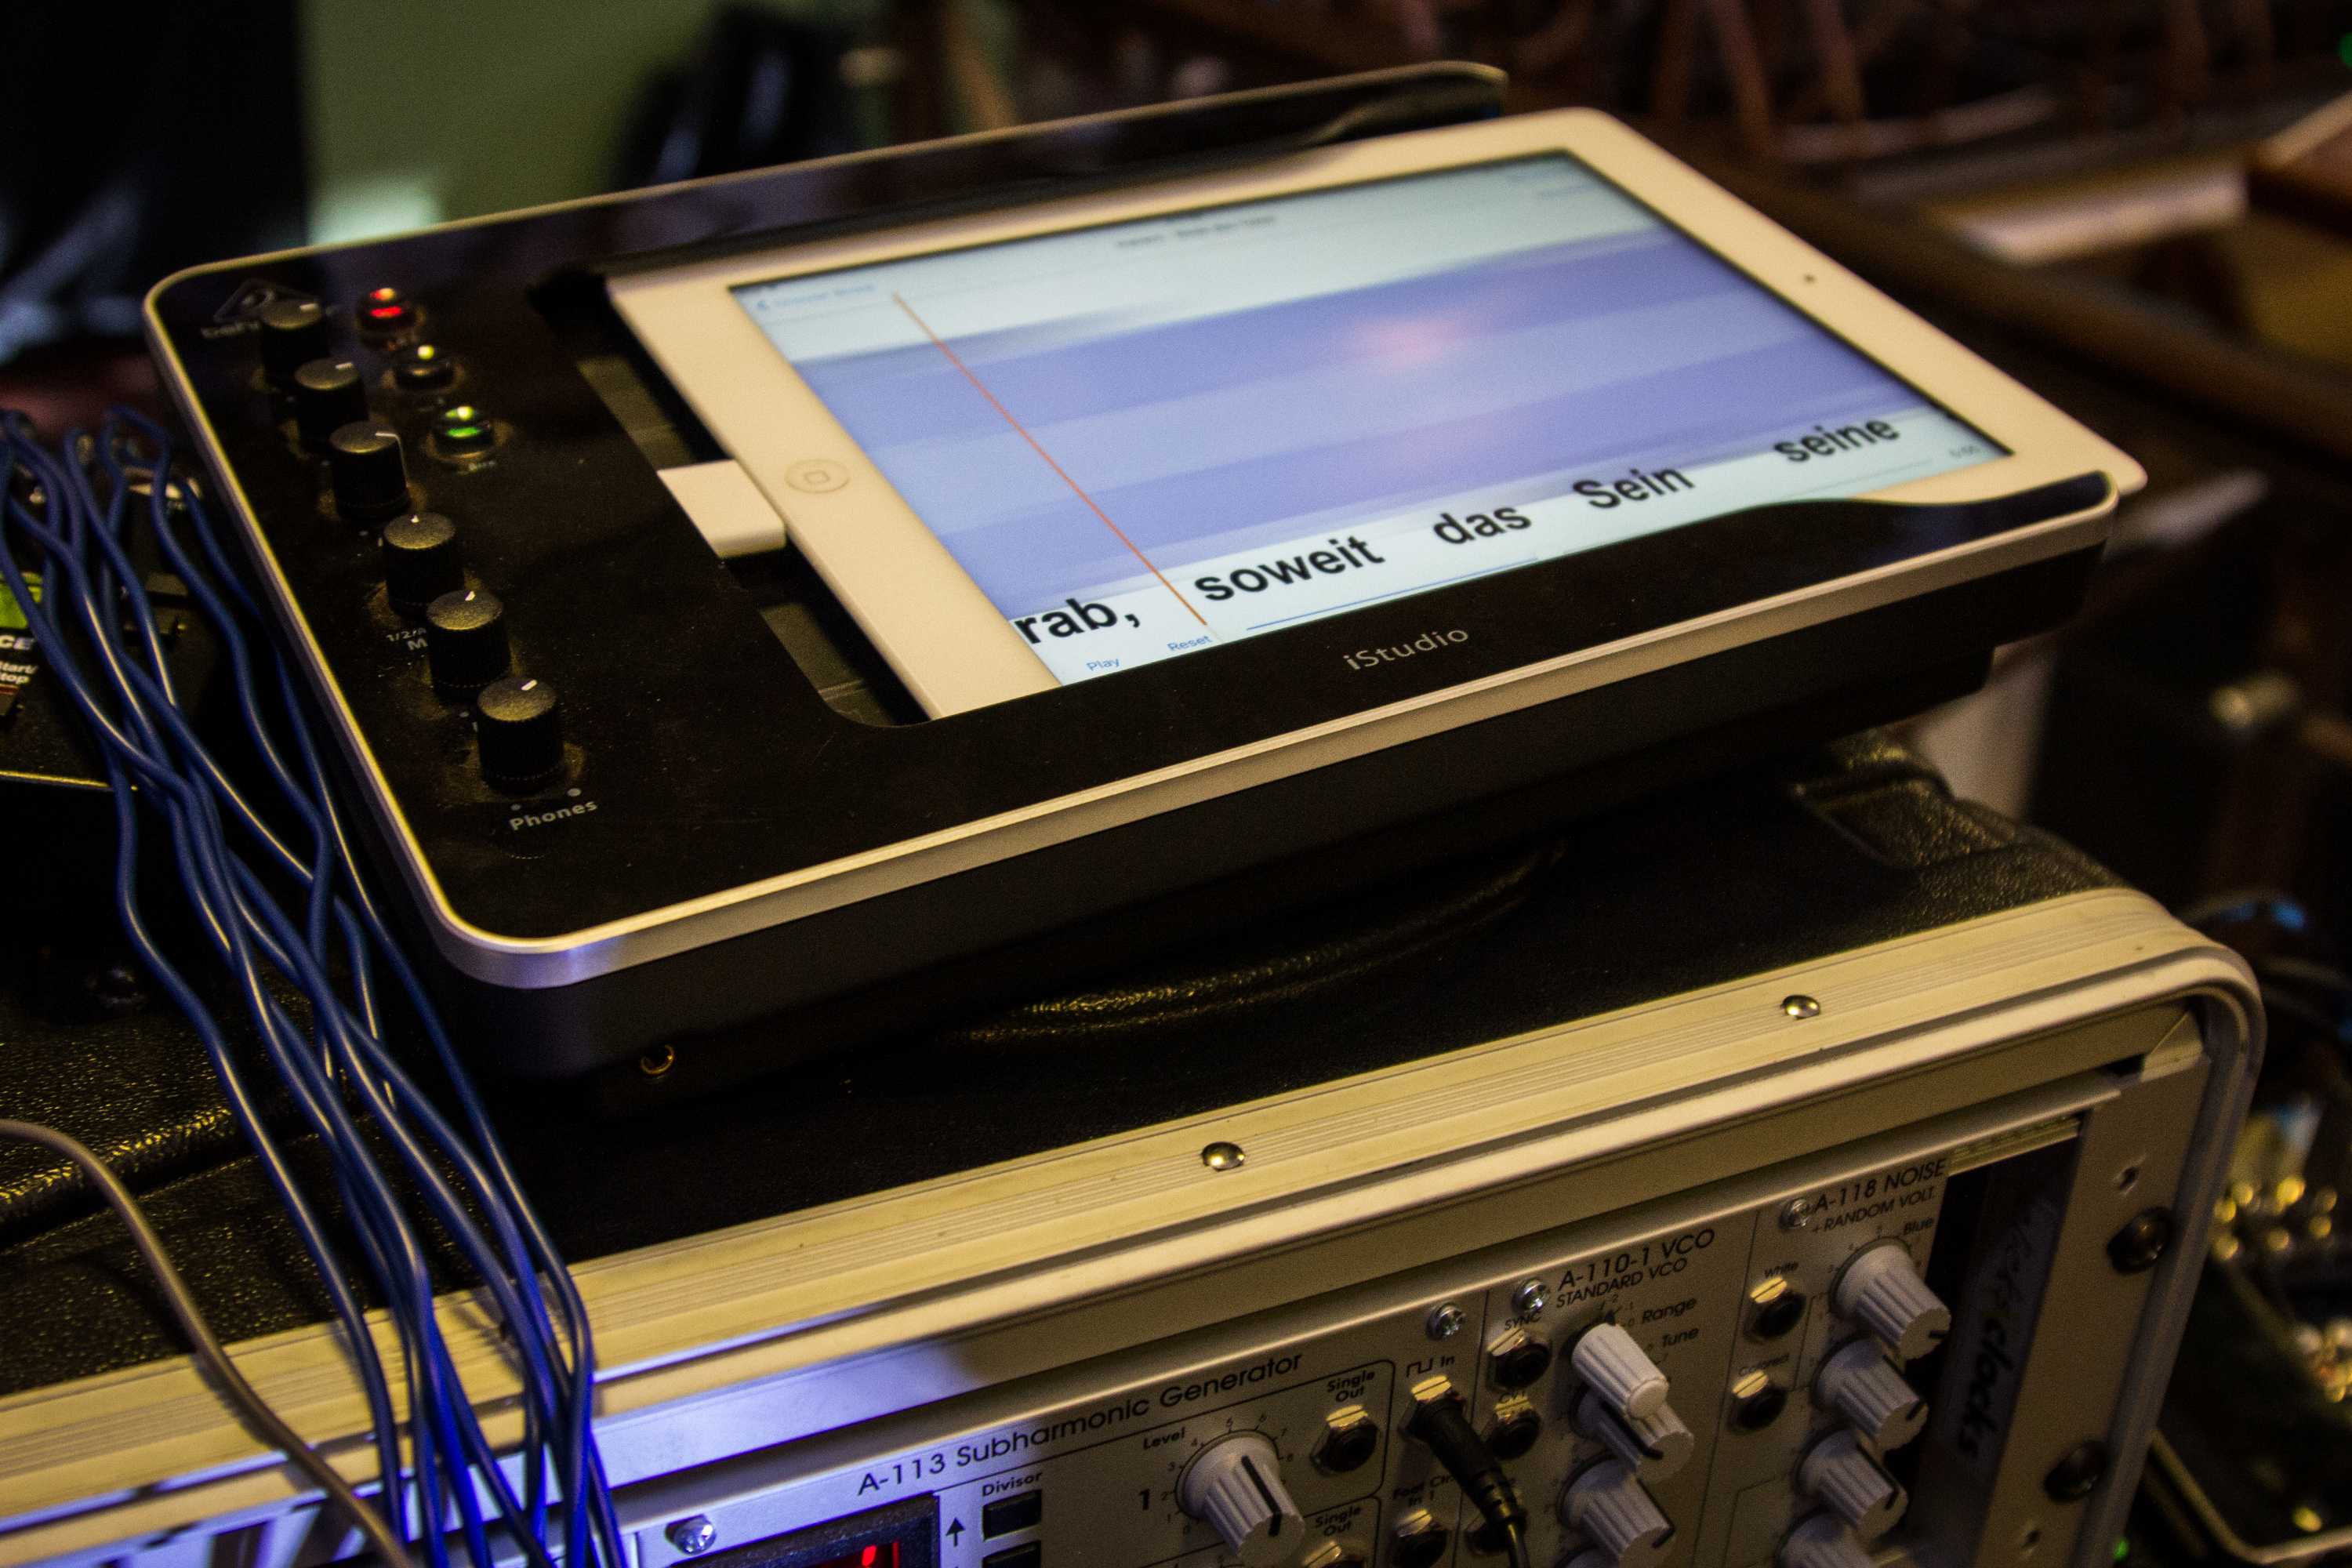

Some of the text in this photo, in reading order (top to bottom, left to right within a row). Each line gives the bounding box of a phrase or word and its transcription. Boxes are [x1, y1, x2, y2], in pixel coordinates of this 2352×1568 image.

[1014, 419, 1900, 644] rab, soweit das Sein seine
[1167, 635, 1213, 652] Reset
[1342, 630, 1468, 670] iStudio
[1087, 656, 1120, 673] Play
[510, 800, 598, 831] Phones
[1814, 1159, 1947, 1212] A-118 NOISE
[1824, 1200, 1894, 1232] RANDOM
[1558, 1229, 1715, 1290] A-110-1 VCO
[1556, 1258, 1687, 1308] STANDARD VCO
[1504, 1311, 1548, 1331] SYNC
[1642, 1298, 1697, 1324] Range
[1661, 1327, 1700, 1348] Tune
[1440, 1356, 1455, 1368] In
[1327, 1370, 1375, 1394] Single
[1335, 1385, 1365, 1403] Out
[857, 1353, 1303, 1496] A-113 Subharmonic Generator
[1142, 1426, 1186, 1450] Level
[982, 1471, 1043, 1497] Divisor
[1139, 1488, 1151, 1511] 1
[1315, 1504, 1362, 1526] Single
[1323, 1521, 1352, 1537] Out
